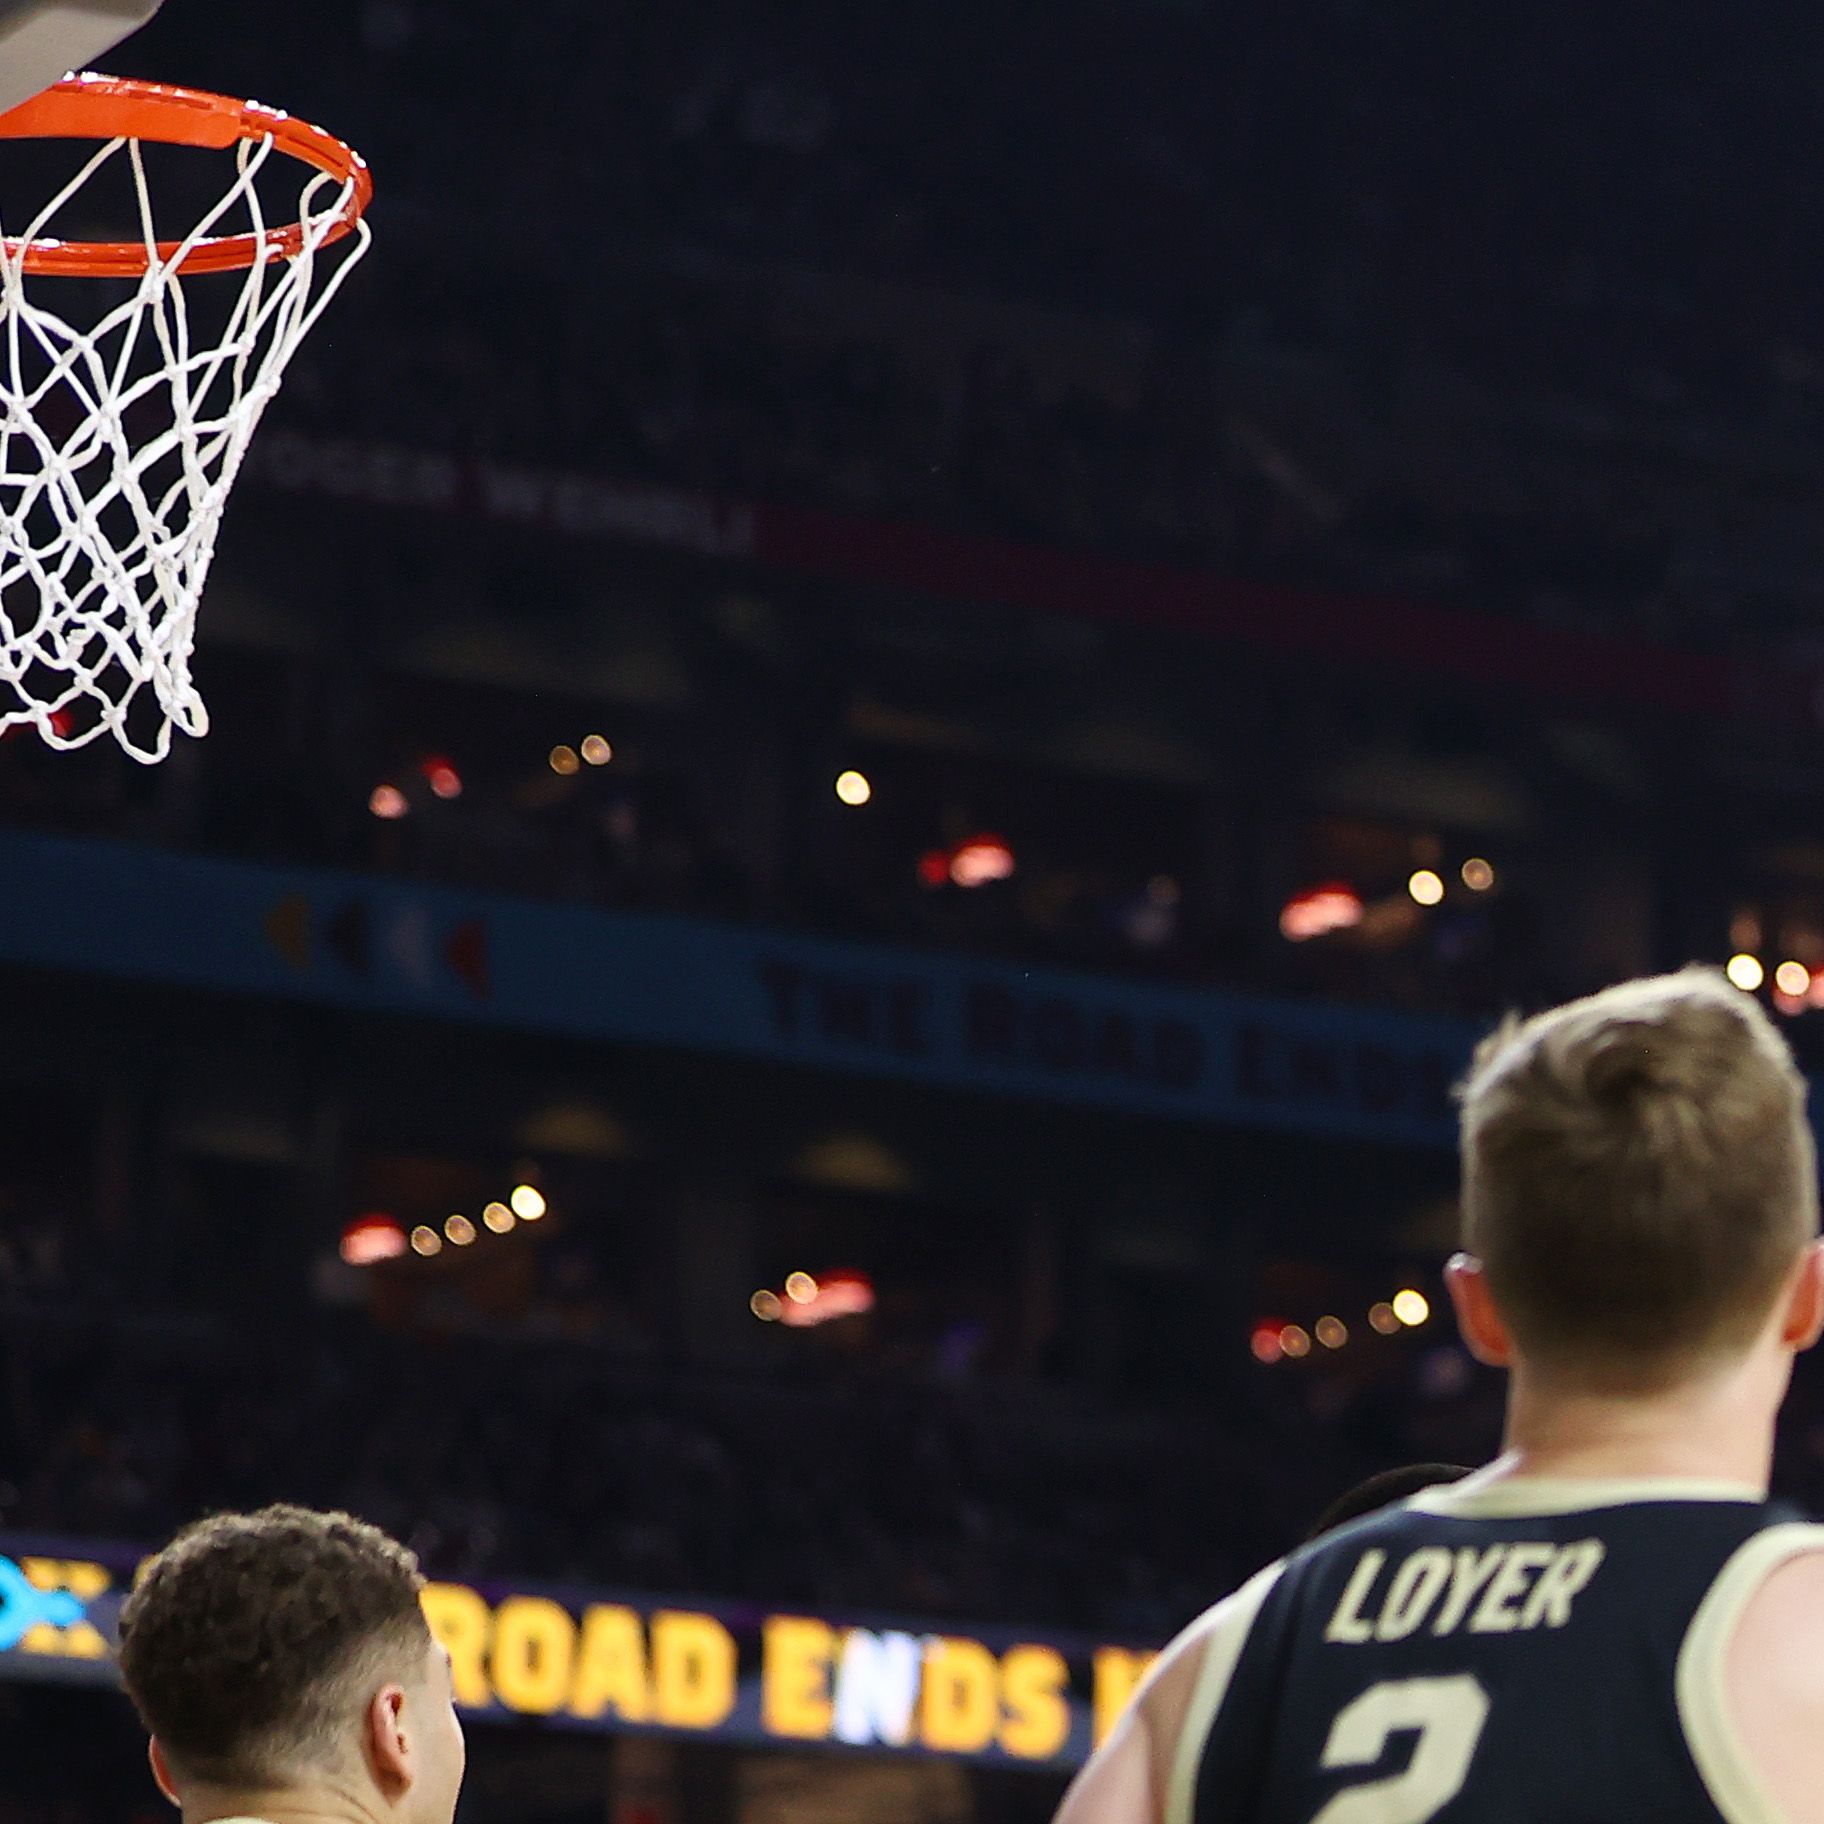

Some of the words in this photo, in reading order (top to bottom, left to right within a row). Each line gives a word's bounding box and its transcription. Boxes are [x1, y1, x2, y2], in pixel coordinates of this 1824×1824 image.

[1325, 1536, 1606, 1645] LOYER
[418, 1580, 738, 1732] ROAD
[760, 1612, 1072, 1762] ENDS
